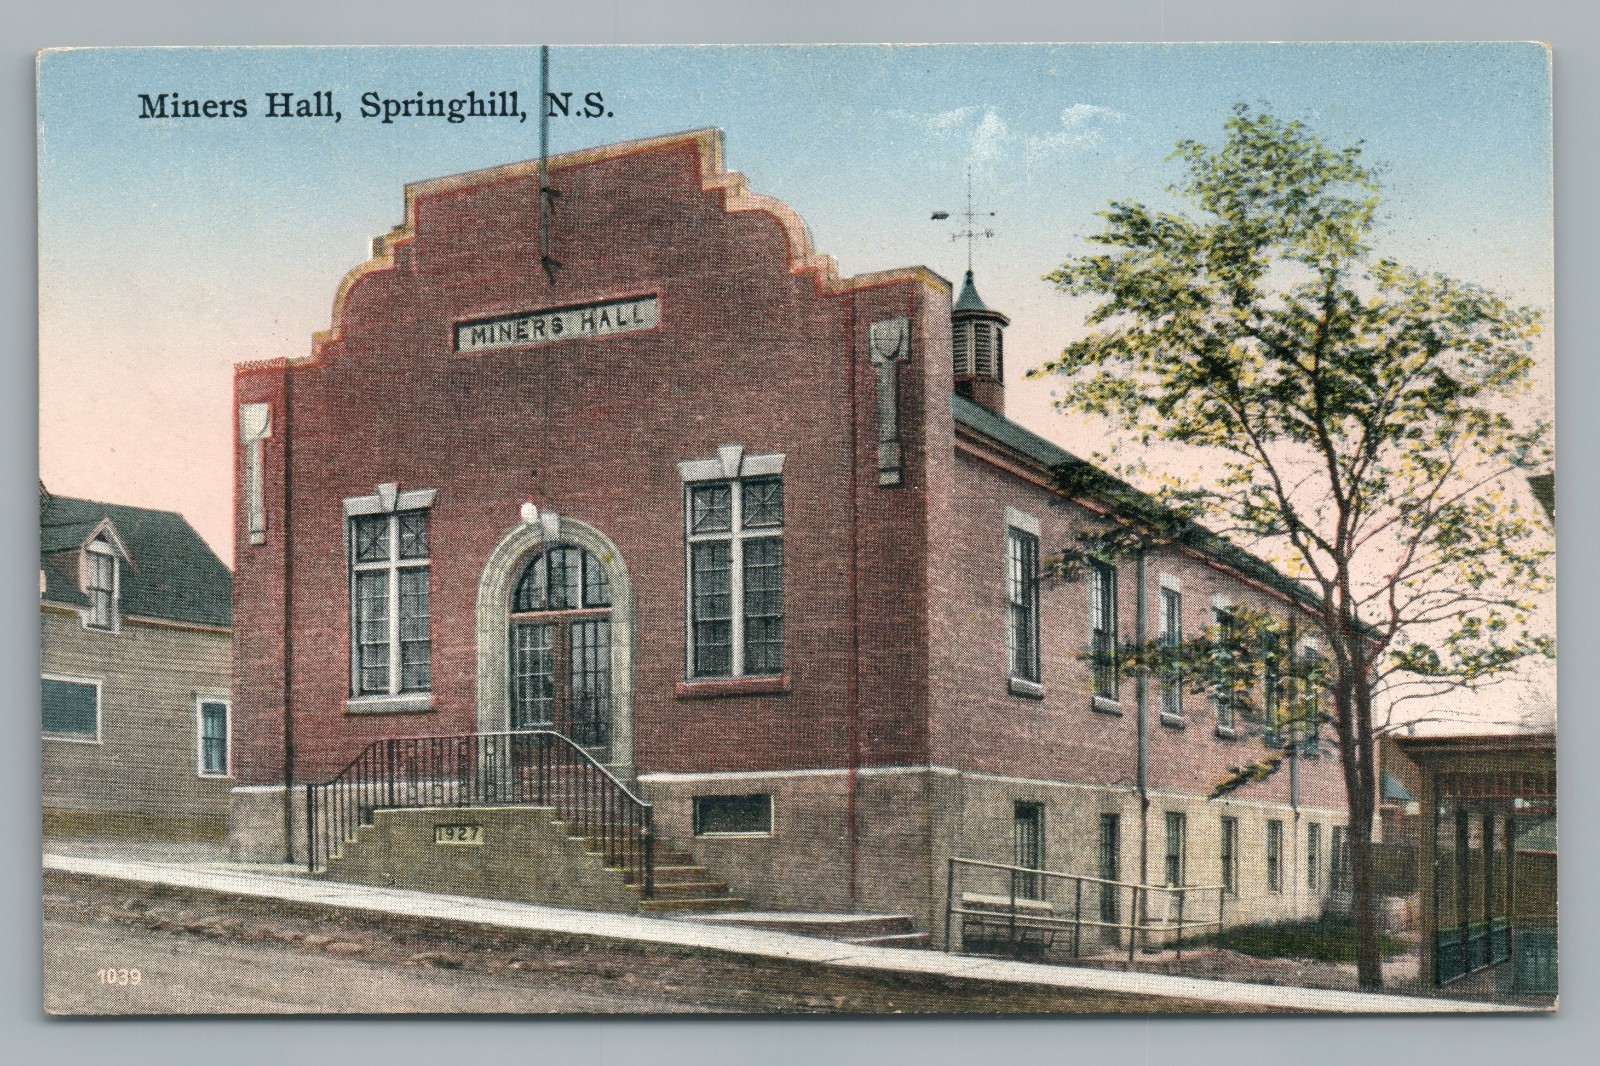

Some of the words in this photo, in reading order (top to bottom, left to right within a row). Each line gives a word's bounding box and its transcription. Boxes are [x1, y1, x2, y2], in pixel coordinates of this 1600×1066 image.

[471, 317, 563, 346] MINERS
[581, 305, 644, 332] HALL
[438, 826, 478, 841] 1927
